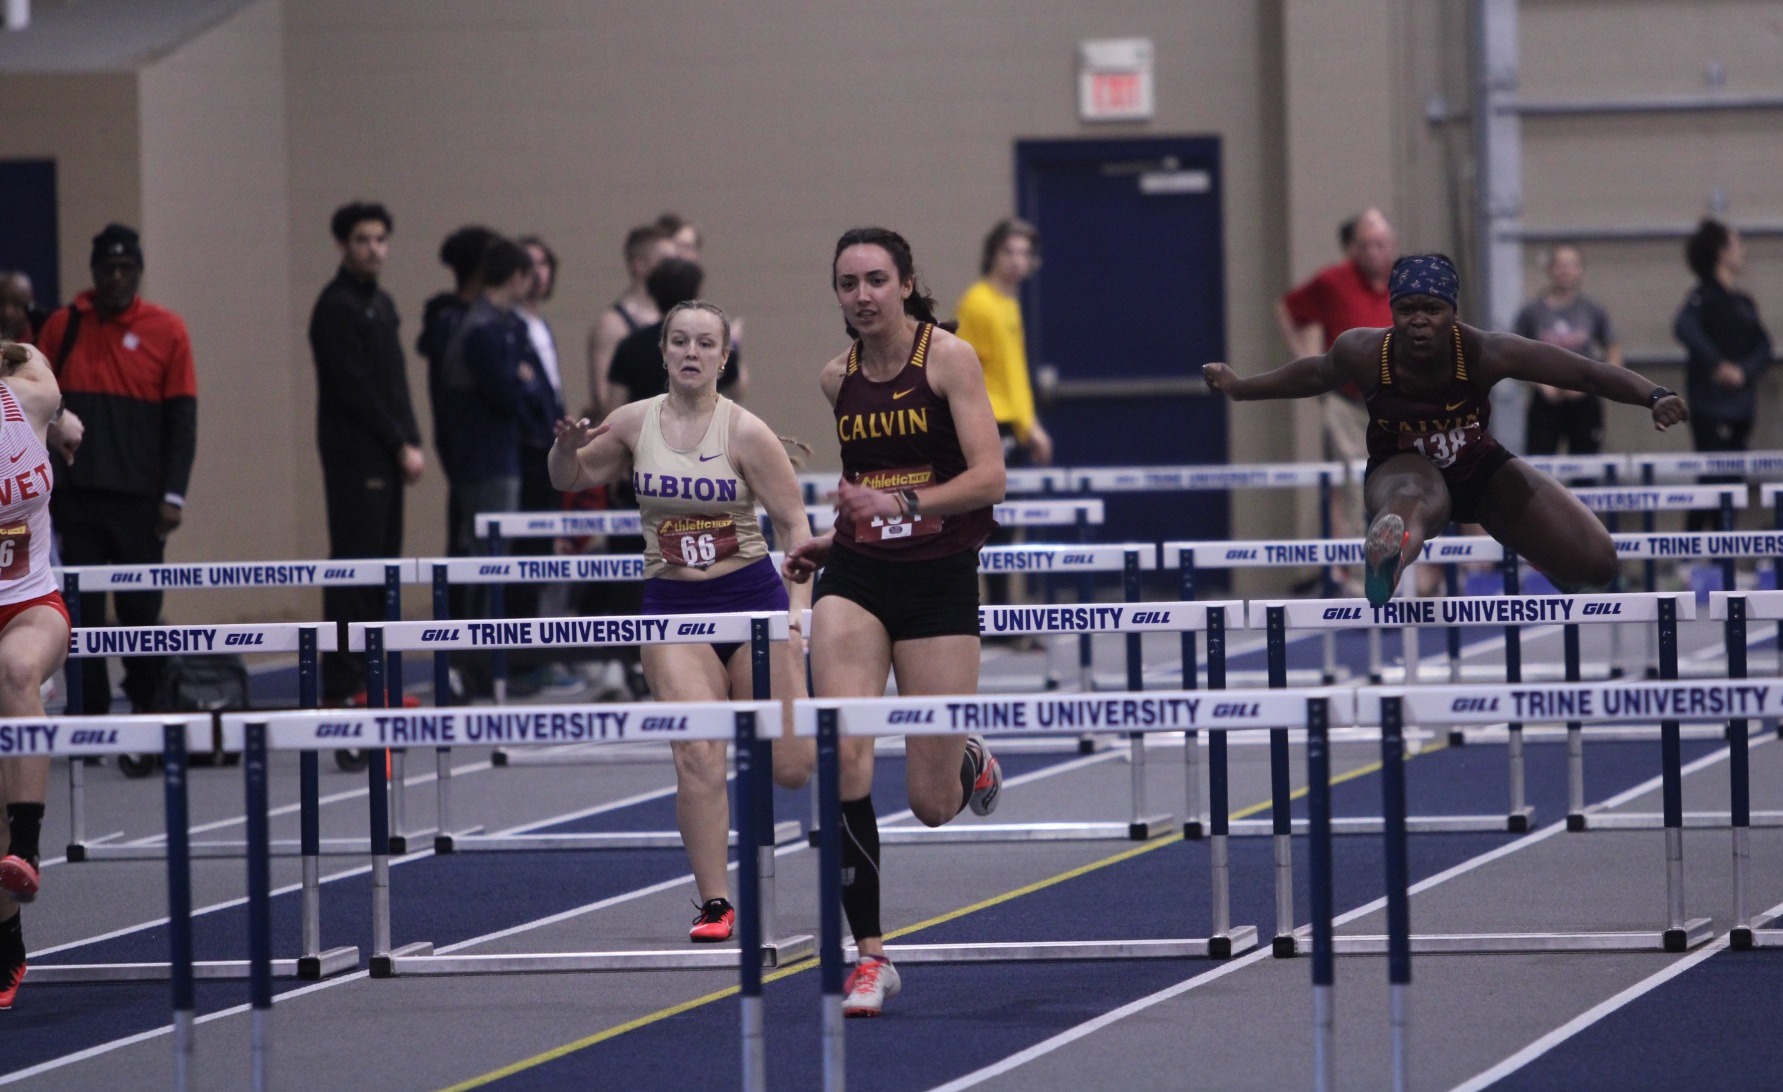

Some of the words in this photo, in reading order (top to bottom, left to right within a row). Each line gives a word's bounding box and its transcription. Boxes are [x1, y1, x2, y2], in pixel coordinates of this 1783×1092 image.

[839, 408, 928, 441] CALVIN
[1413, 427, 1467, 460] 138
[634, 472, 737, 501] ALBION
[680, 534, 716, 564] 66
[1226, 549, 1258, 560] GILL
[1265, 546, 1318, 563] TRINE
[1440, 545, 1473, 556] GILL
[1647, 537, 1702, 555] TRINE
[111, 572, 143, 584] GILL
[149, 567, 203, 586] TRINE
[209, 565, 316, 585] UNIVERSITY
[324, 568, 356, 580] GILL
[518, 560, 571, 579] TRINE
[993, 607, 1124, 632] UNIVERSITY
[1131, 611, 1171, 624] GILL
[1322, 607, 1362, 620] GILL
[1370, 601, 1435, 624] TRINE
[1442, 599, 1574, 623] UNIVERSITY
[1582, 602, 1622, 616] GILL
[86, 629, 217, 653] UNIVERSITY
[225, 632, 264, 646] GILL
[421, 628, 460, 643] GILL
[467, 623, 532, 645] TRINE
[539, 619, 669, 643] UNIVERSITY
[677, 622, 716, 636] GILL
[1451, 697, 1500, 713] GILL
[1510, 691, 1593, 717] TRINE
[1604, 686, 1770, 715] UNIVERSITY
[887, 708, 935, 724] GILL
[947, 703, 1027, 729] TRINE
[1036, 700, 1199, 727] UNIVERSITY
[1212, 702, 1260, 718] GILL
[70, 729, 118, 745] GILL
[316, 722, 364, 739] GILL
[375, 716, 456, 743] TRINE
[465, 712, 630, 740] UNIVERSITY
[640, 715, 689, 732] GILL
